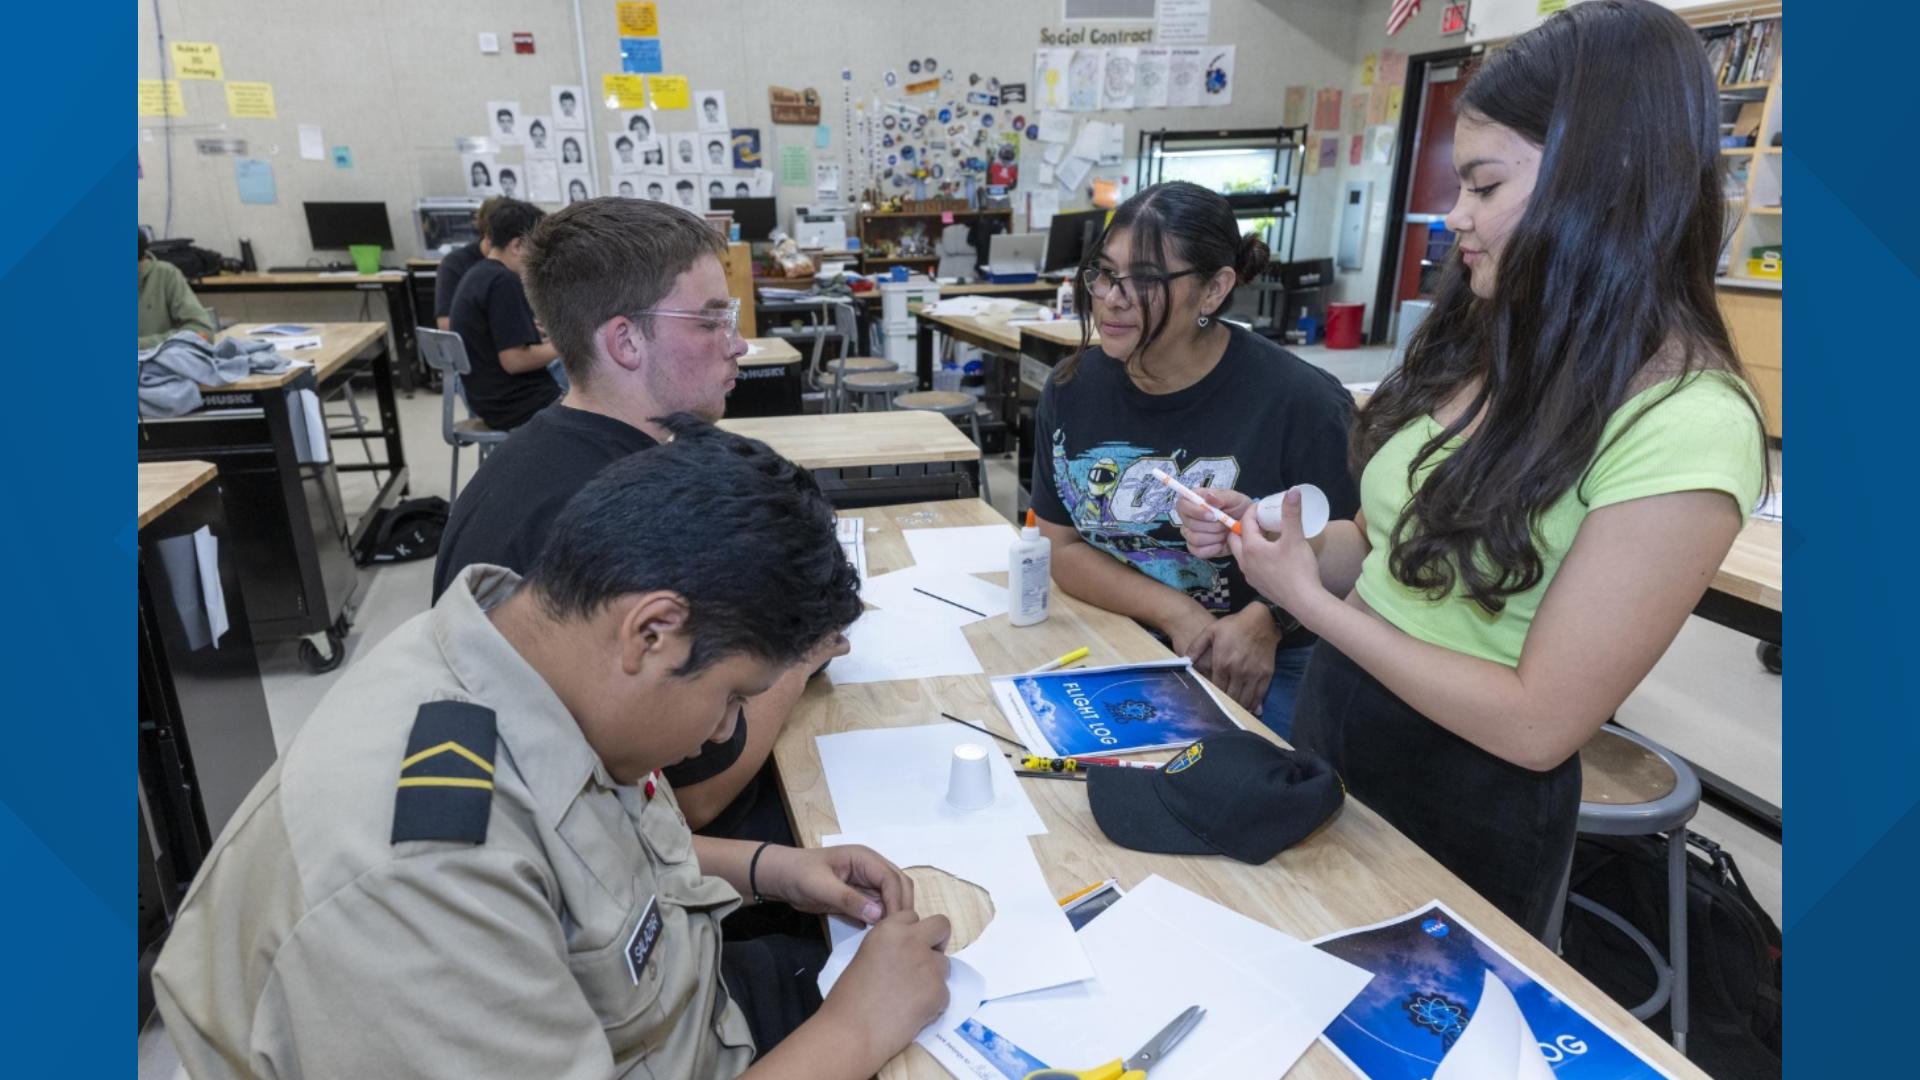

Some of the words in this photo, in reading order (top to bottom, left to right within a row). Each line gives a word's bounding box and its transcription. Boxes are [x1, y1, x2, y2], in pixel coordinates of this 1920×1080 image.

[1040, 27, 1086, 46] Social
[1090, 28, 1153, 45] Contract
[747, 366, 786, 379] HUSKY
[206, 393, 255, 406] HUSKY
[1062, 682, 1101, 719] FLIGHT
[1089, 722, 1118, 745] LOG
[634, 912, 661, 965] SALAZAR
[1537, 1034, 1589, 1064] OG
